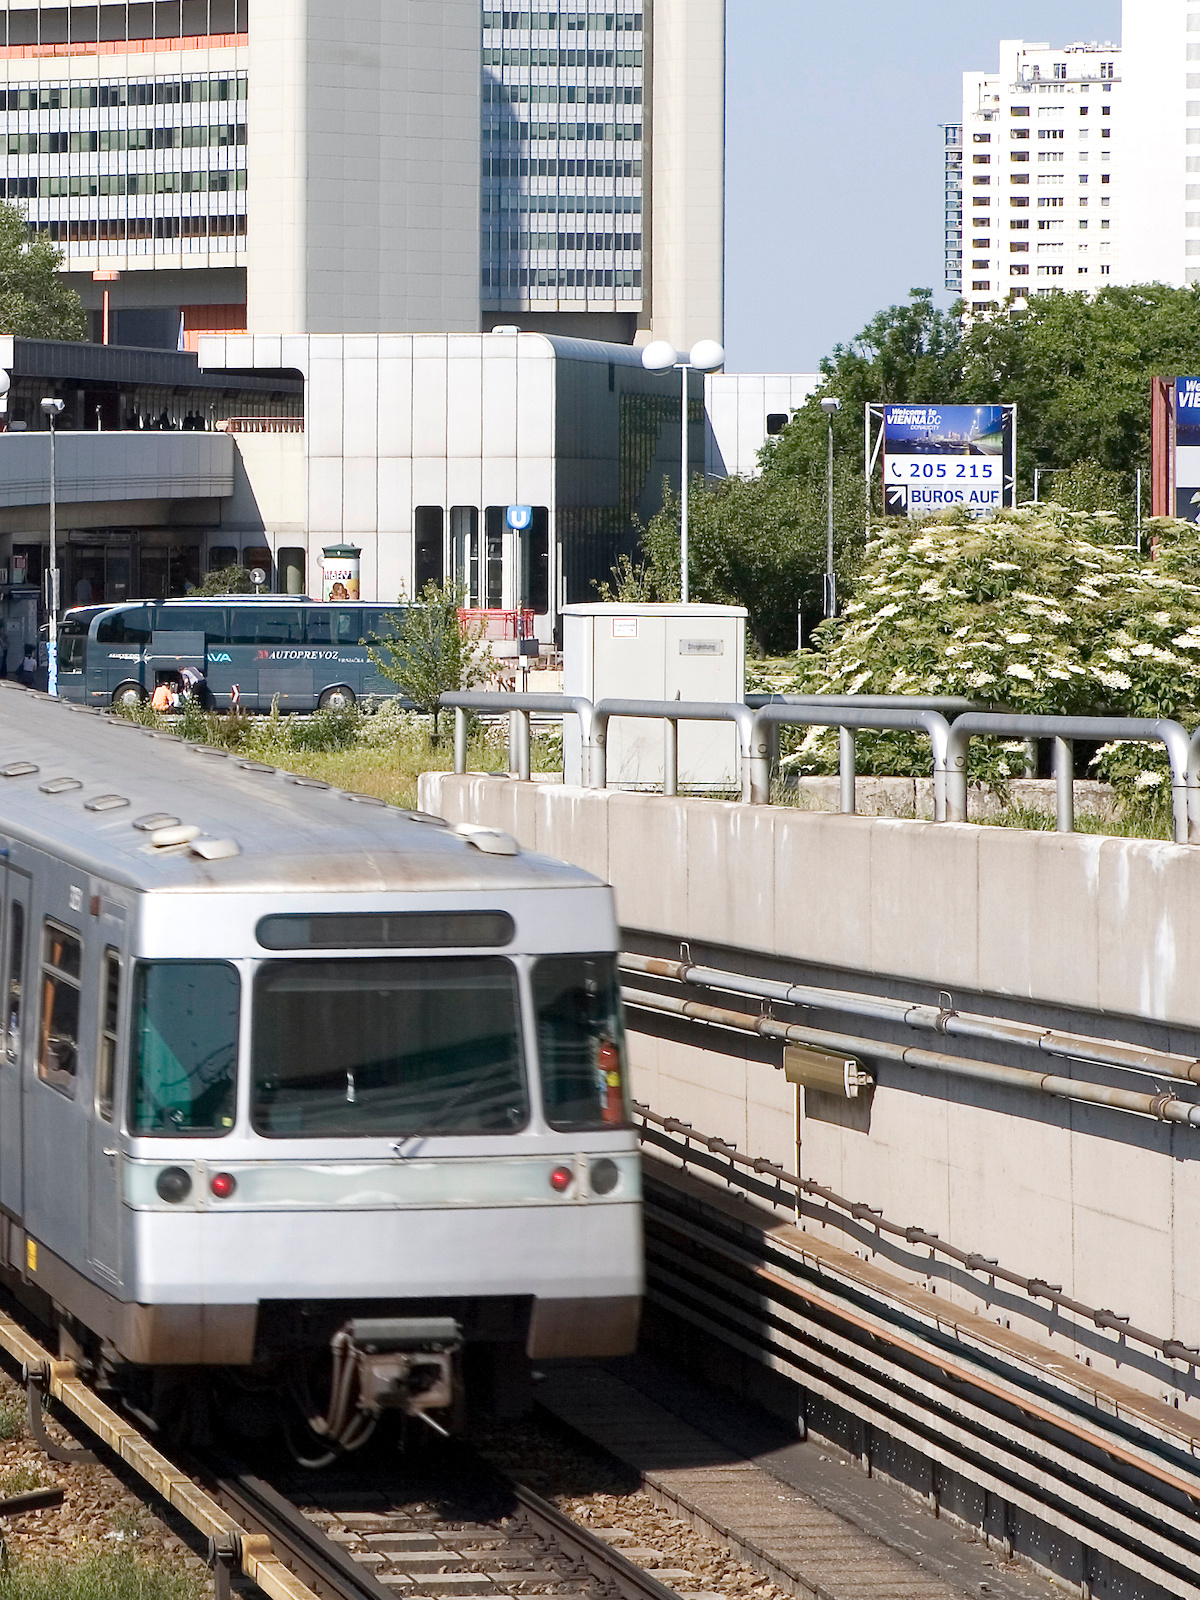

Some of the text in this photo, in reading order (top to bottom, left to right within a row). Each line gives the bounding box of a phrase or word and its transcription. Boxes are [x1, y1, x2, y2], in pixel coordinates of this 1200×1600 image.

[892, 408, 937, 416] Welcome to
[910, 463, 993, 478] 205 215
[911, 486, 1000, 503] BÜROS AUF
[511, 510, 527, 527] U
[268, 650, 339, 660] AUTOPREVOZ
